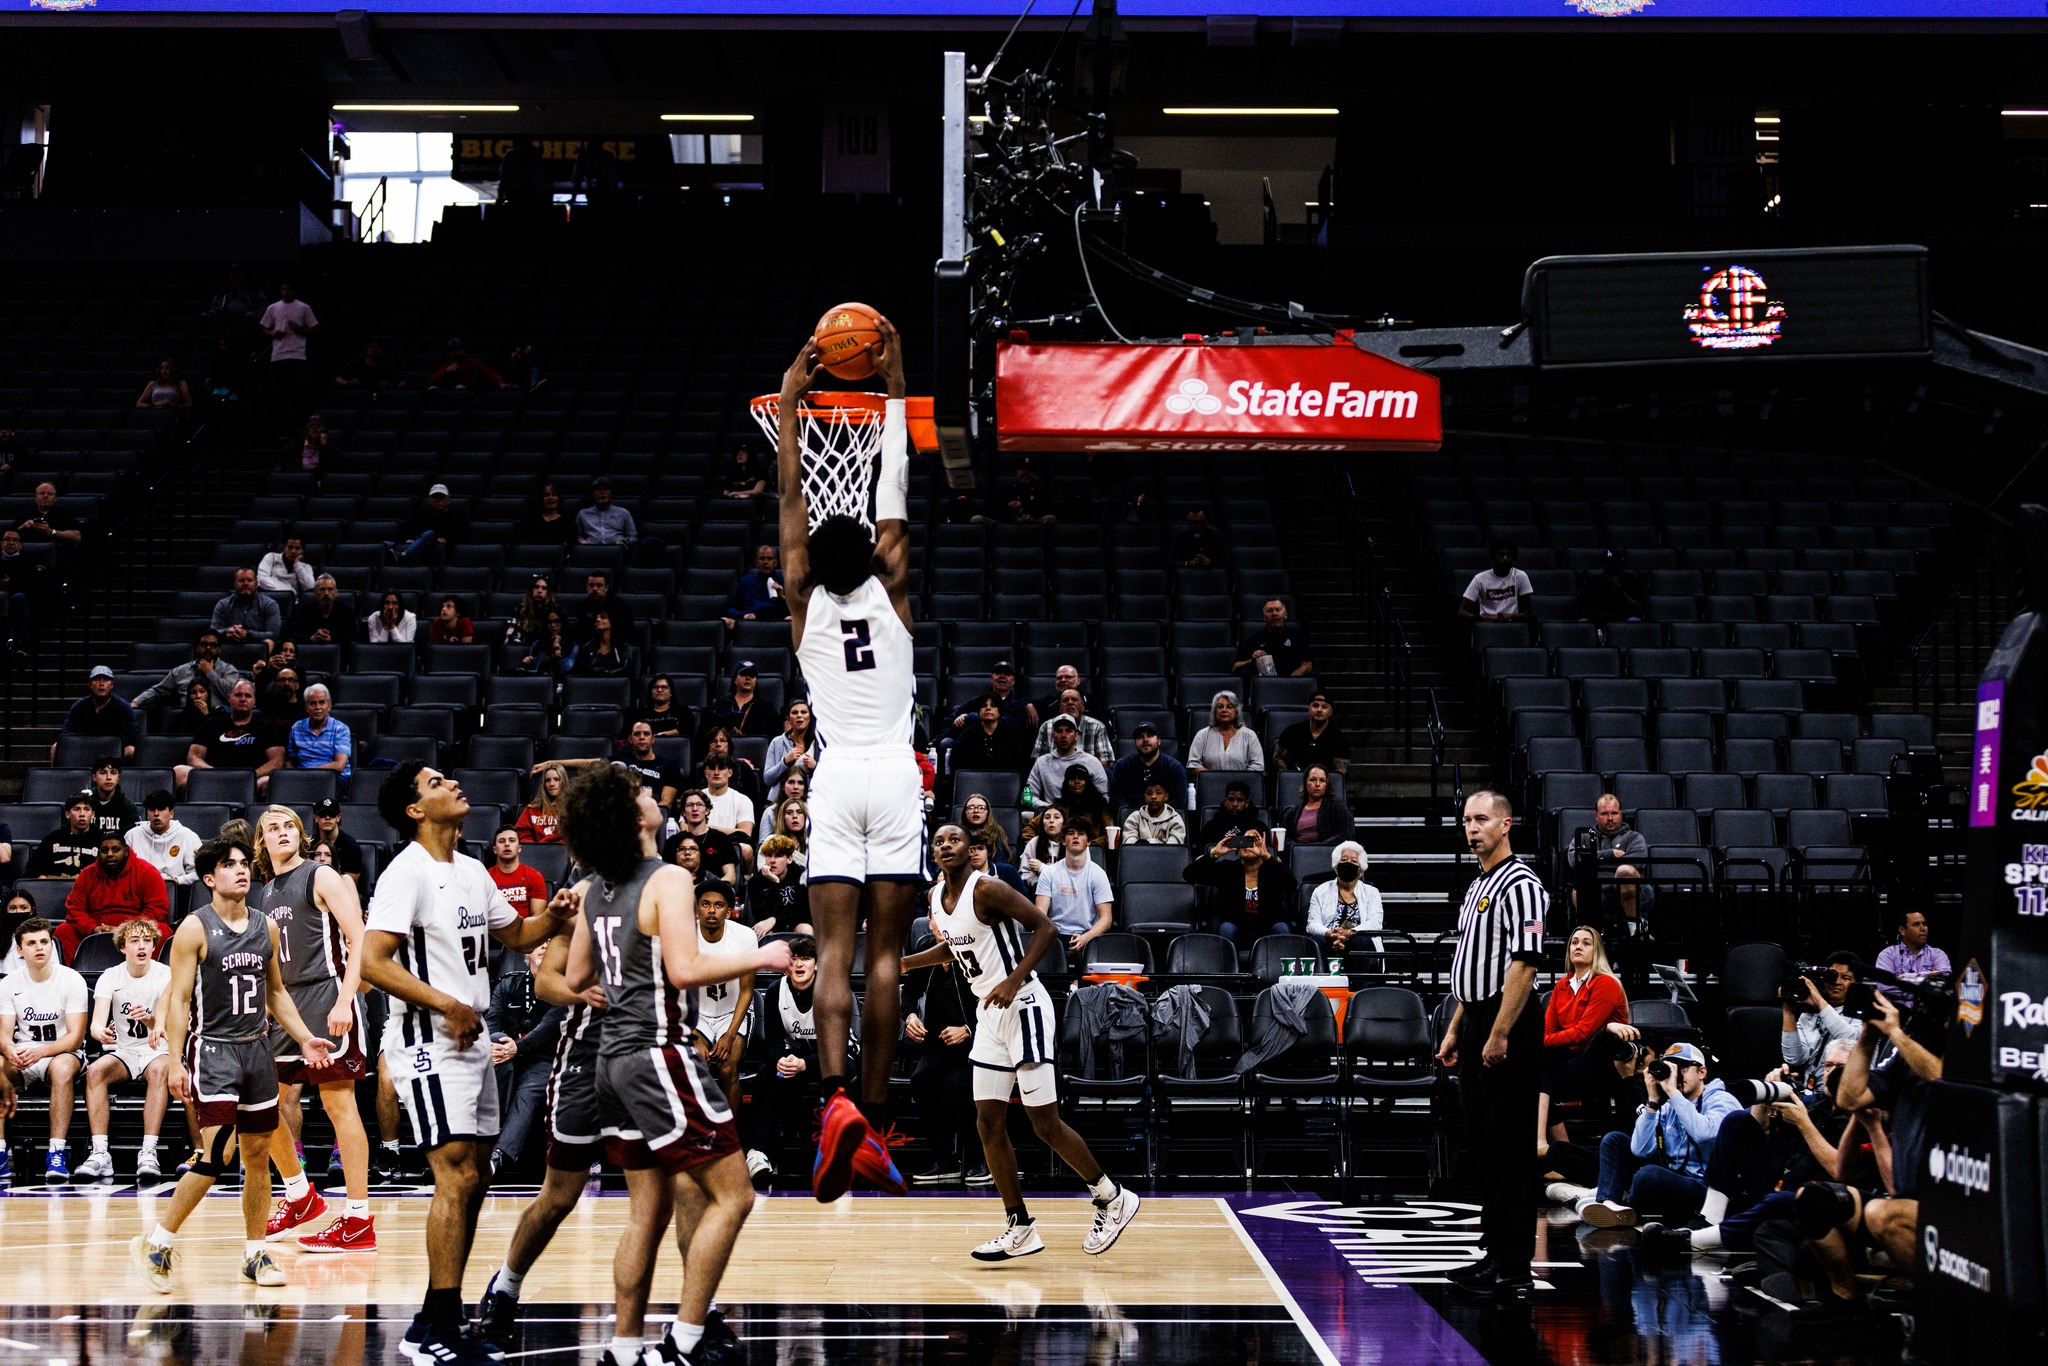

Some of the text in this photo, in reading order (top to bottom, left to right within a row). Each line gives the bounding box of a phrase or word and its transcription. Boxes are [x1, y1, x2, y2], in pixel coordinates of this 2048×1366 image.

[460, 137, 637, 160] BIG HESE
[838, 114, 878, 155] 108
[1225, 380, 1418, 419] State Farm
[1149, 441, 1347, 451] State Farm
[840, 618, 877, 673] 2
[593, 916, 623, 987] 15
[942, 929, 976, 947] Braves
[221, 952, 264, 972] SCRIPPS
[229, 974, 258, 1016] 12
[23, 1006, 60, 1022] Braves
[28, 1023, 58, 1042] 30
[1946, 1143, 1991, 1197] dialpad
